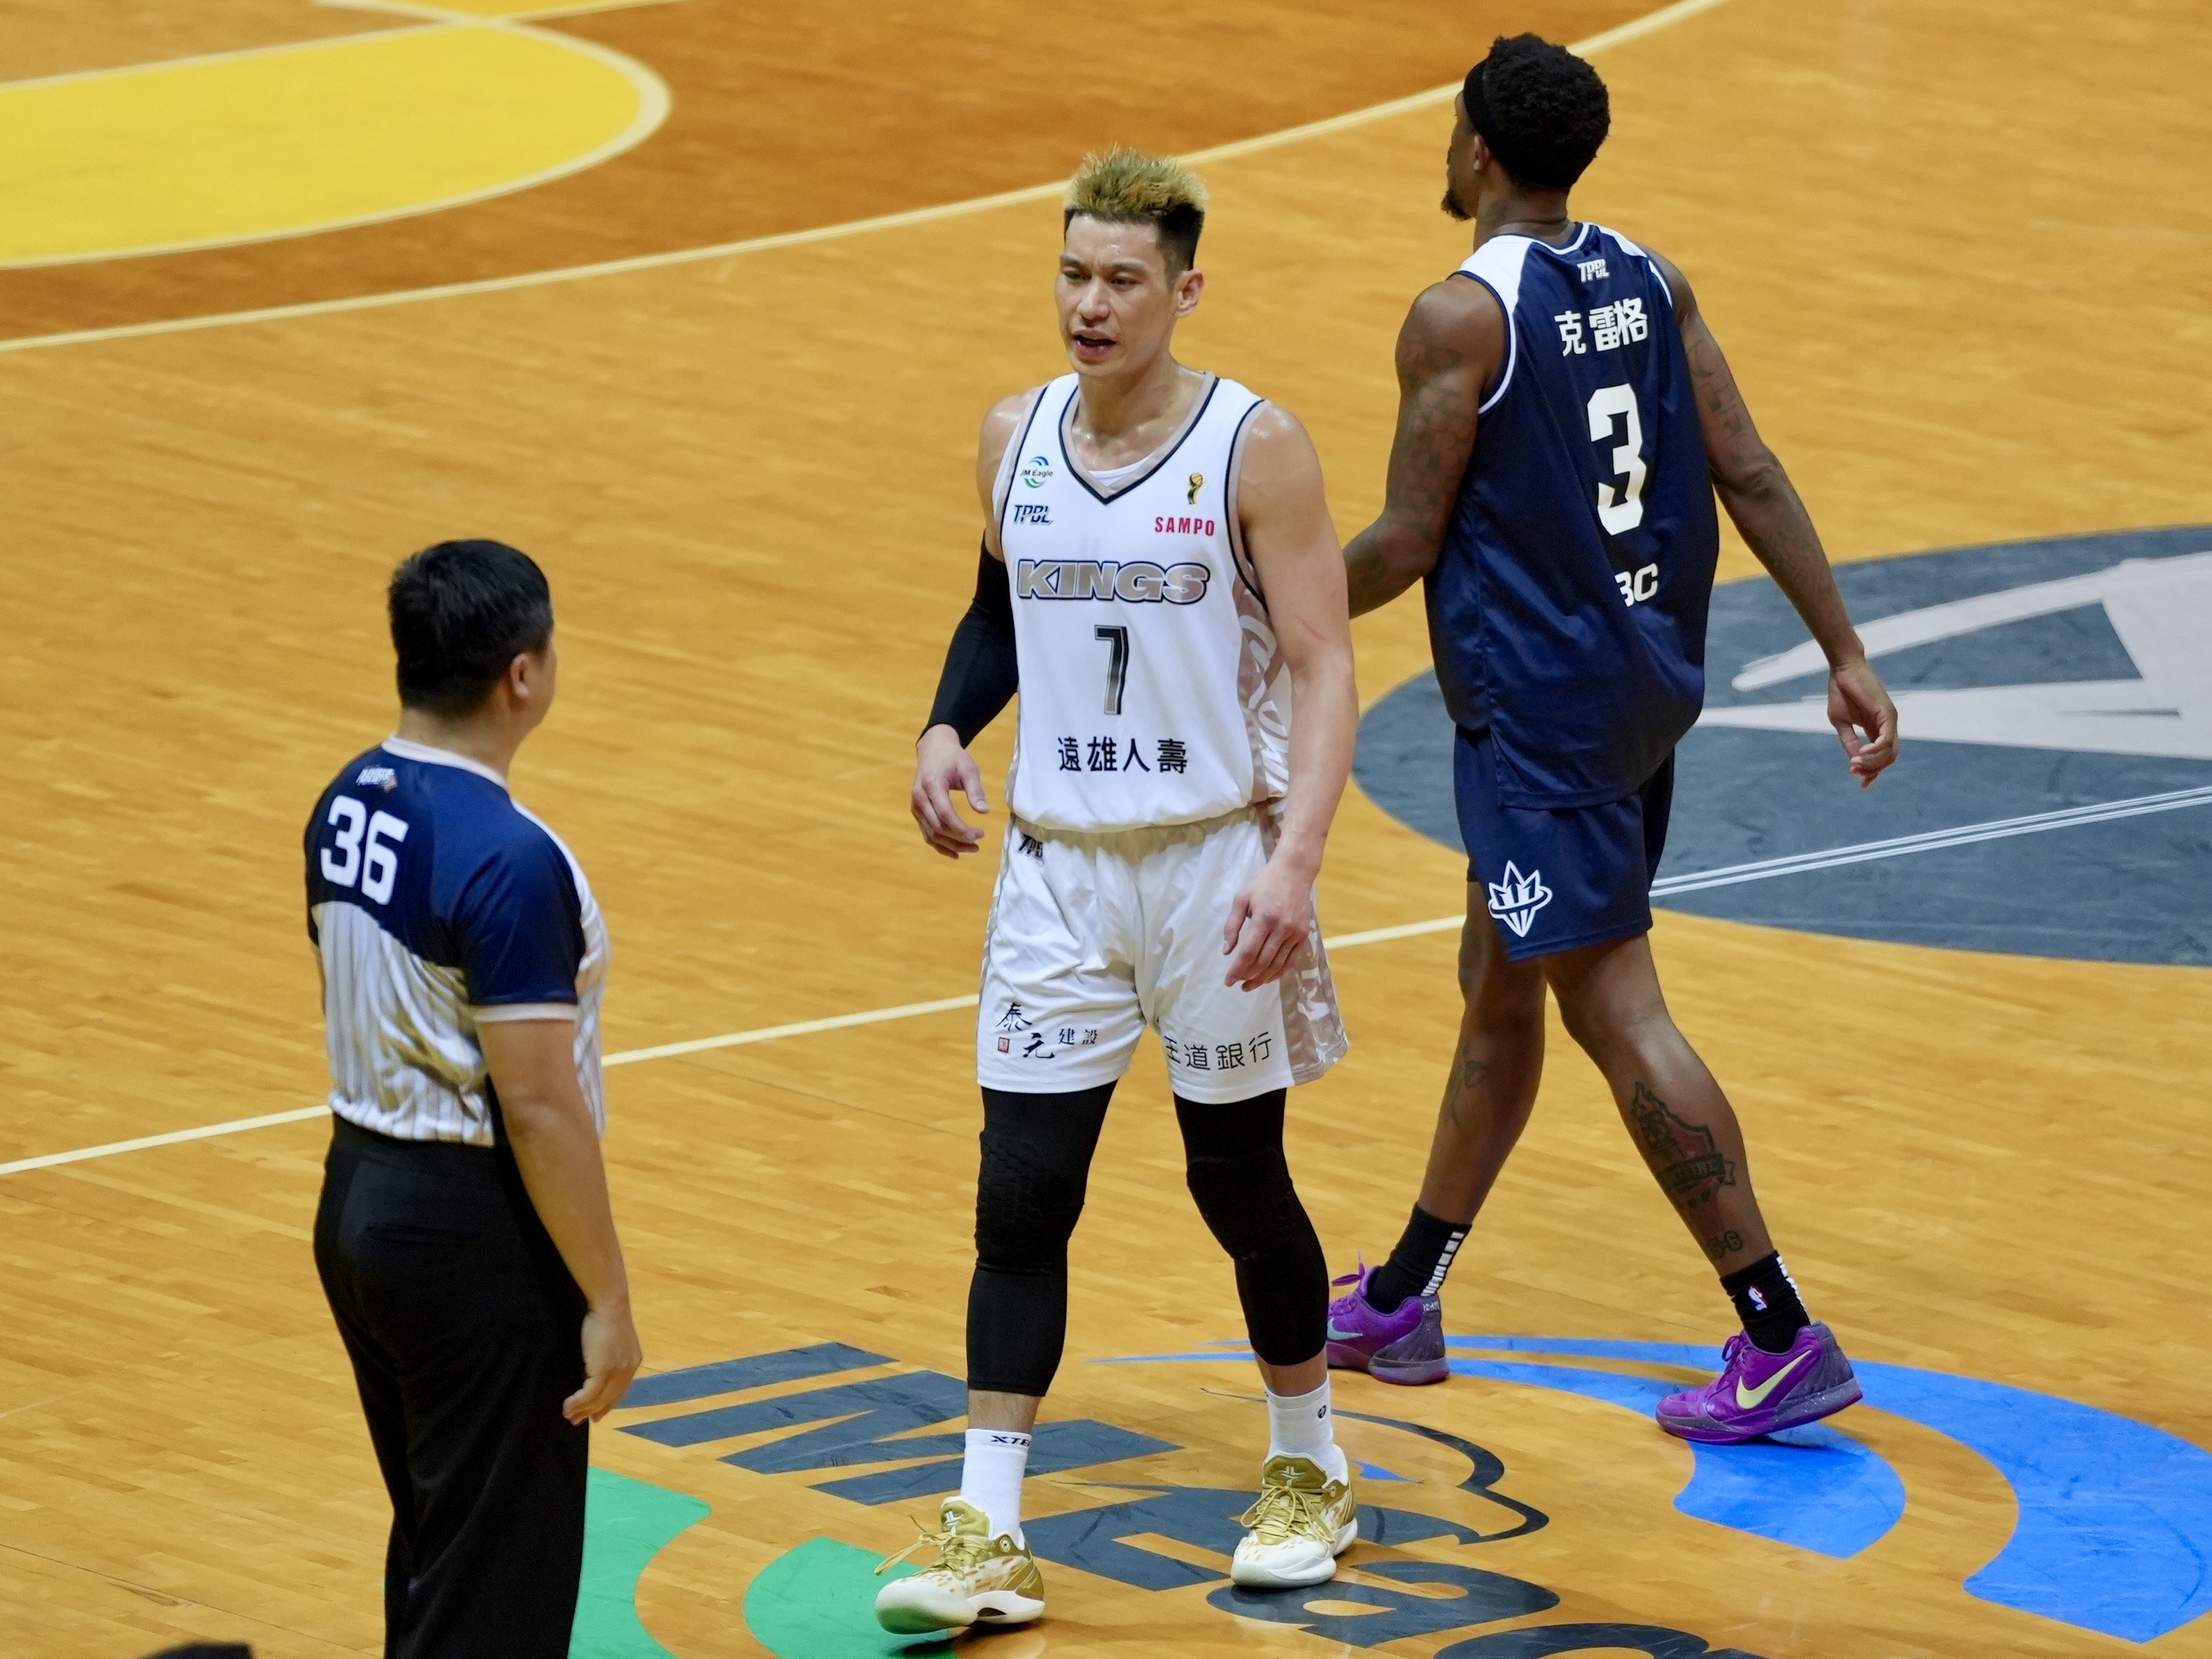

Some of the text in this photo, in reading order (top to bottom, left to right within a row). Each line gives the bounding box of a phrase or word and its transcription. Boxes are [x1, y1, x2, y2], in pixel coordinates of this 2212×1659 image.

[1554, 297, 1648, 357] 克雷格
[1032, 468, 1054, 478] Eagle
[1587, 383, 1647, 536] 3
[1014, 504, 1054, 525] TPBL
[1155, 516, 1216, 537] SAMPO
[1016, 559, 1211, 605] KINGS
[1093, 624, 1130, 715] 7
[1057, 736, 1188, 774] 遠雄人壽
[319, 794, 410, 906] 36
